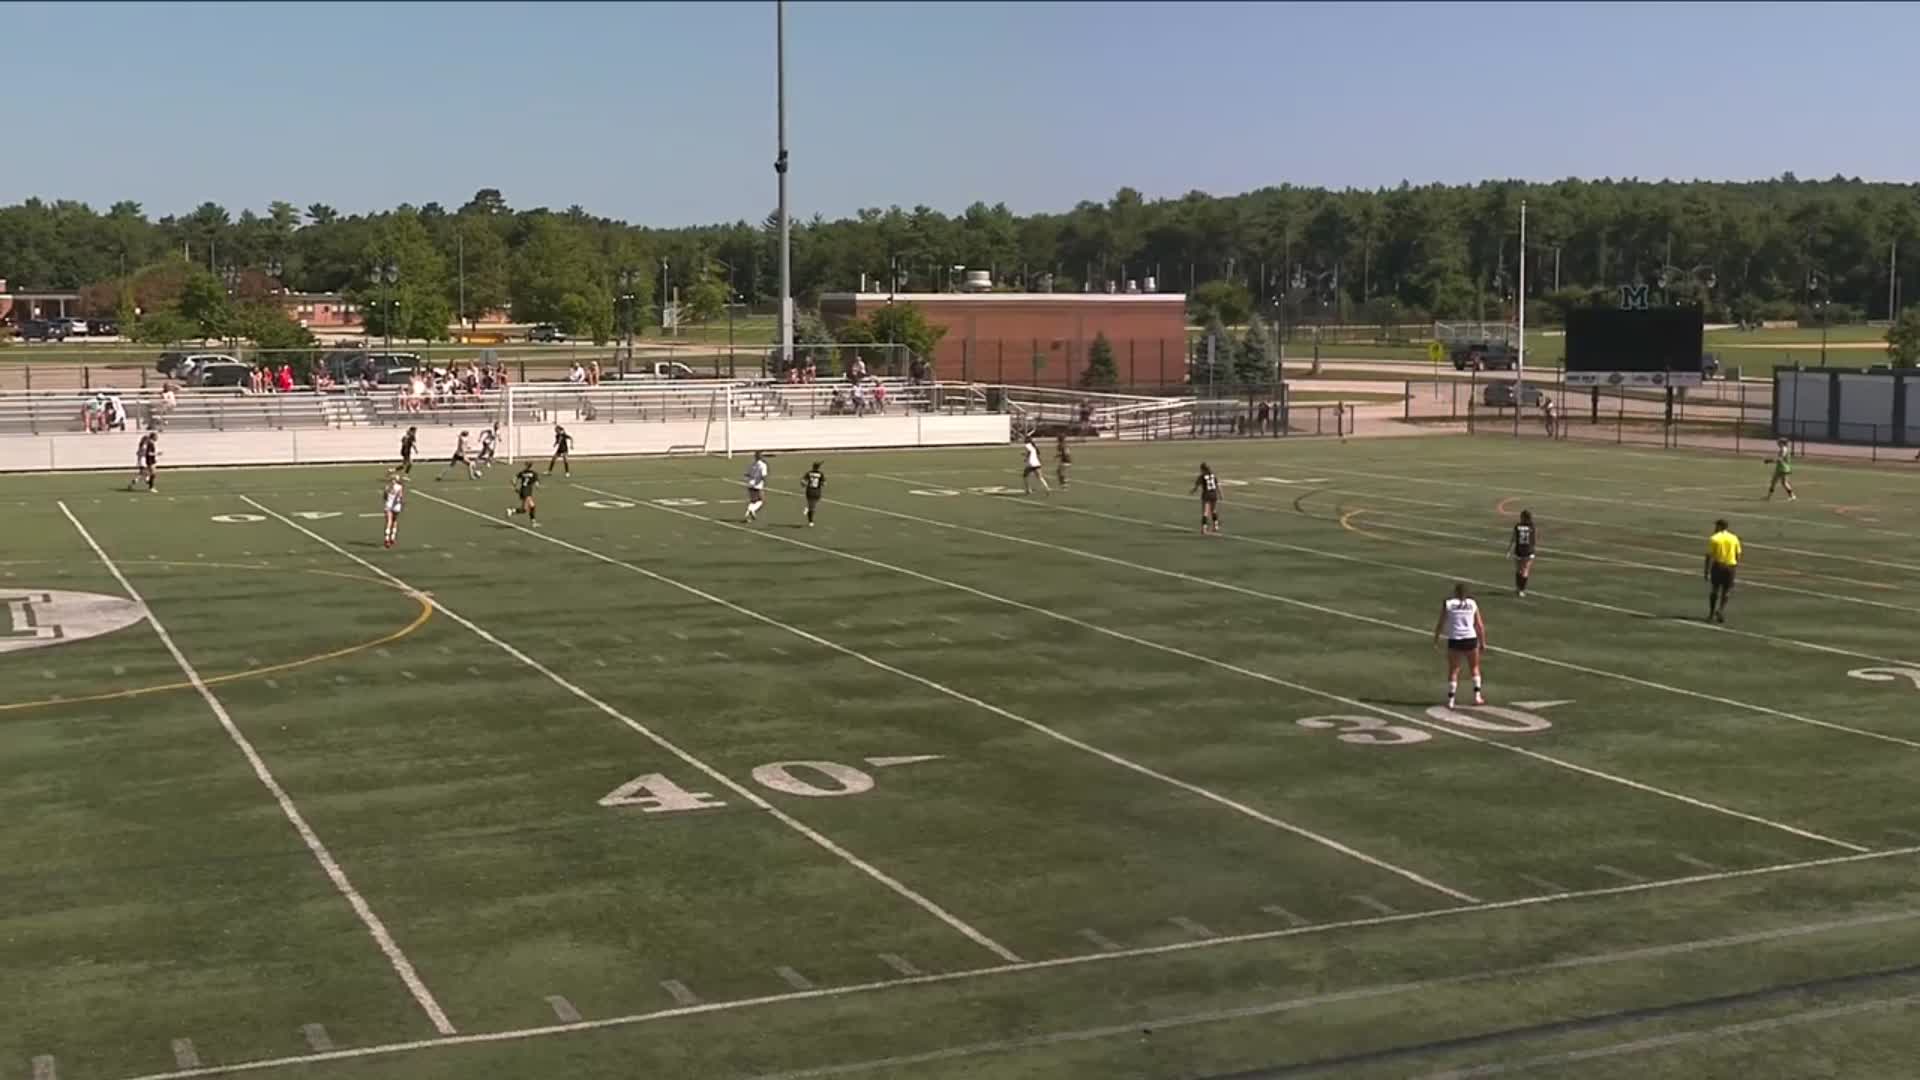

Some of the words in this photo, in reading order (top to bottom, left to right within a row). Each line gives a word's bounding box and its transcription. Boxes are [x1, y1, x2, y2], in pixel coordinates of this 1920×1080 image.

[1620, 285, 1648, 309] M
[1296, 704, 1552, 744] 30
[597, 760, 875, 813] 40
